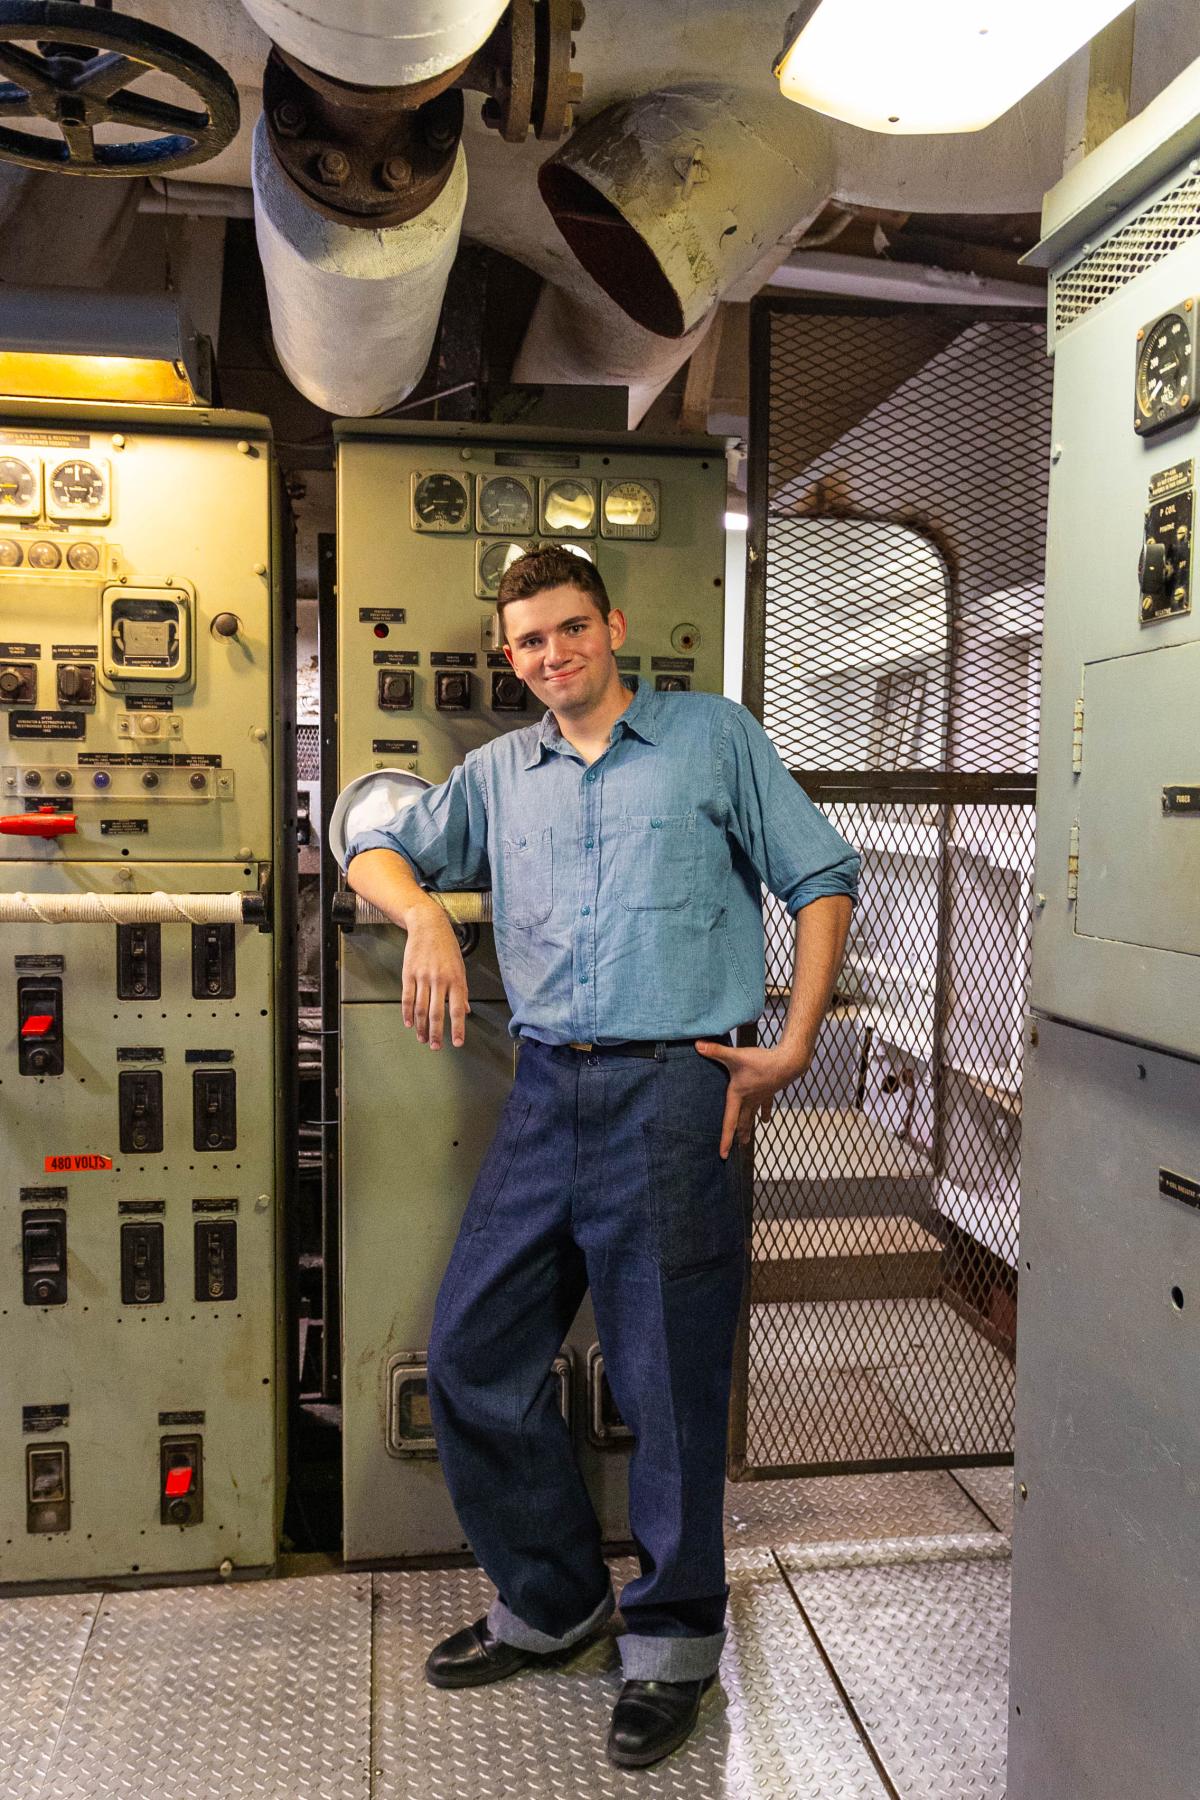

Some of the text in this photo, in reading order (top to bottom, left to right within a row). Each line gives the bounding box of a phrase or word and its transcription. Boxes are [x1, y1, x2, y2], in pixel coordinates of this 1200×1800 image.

[1158, 336, 1167, 349] 300
[1150, 356, 1159, 370] 200
[1159, 504, 1176, 518] P COIL
[51, 1155, 107, 1170] 480 VOLTS
